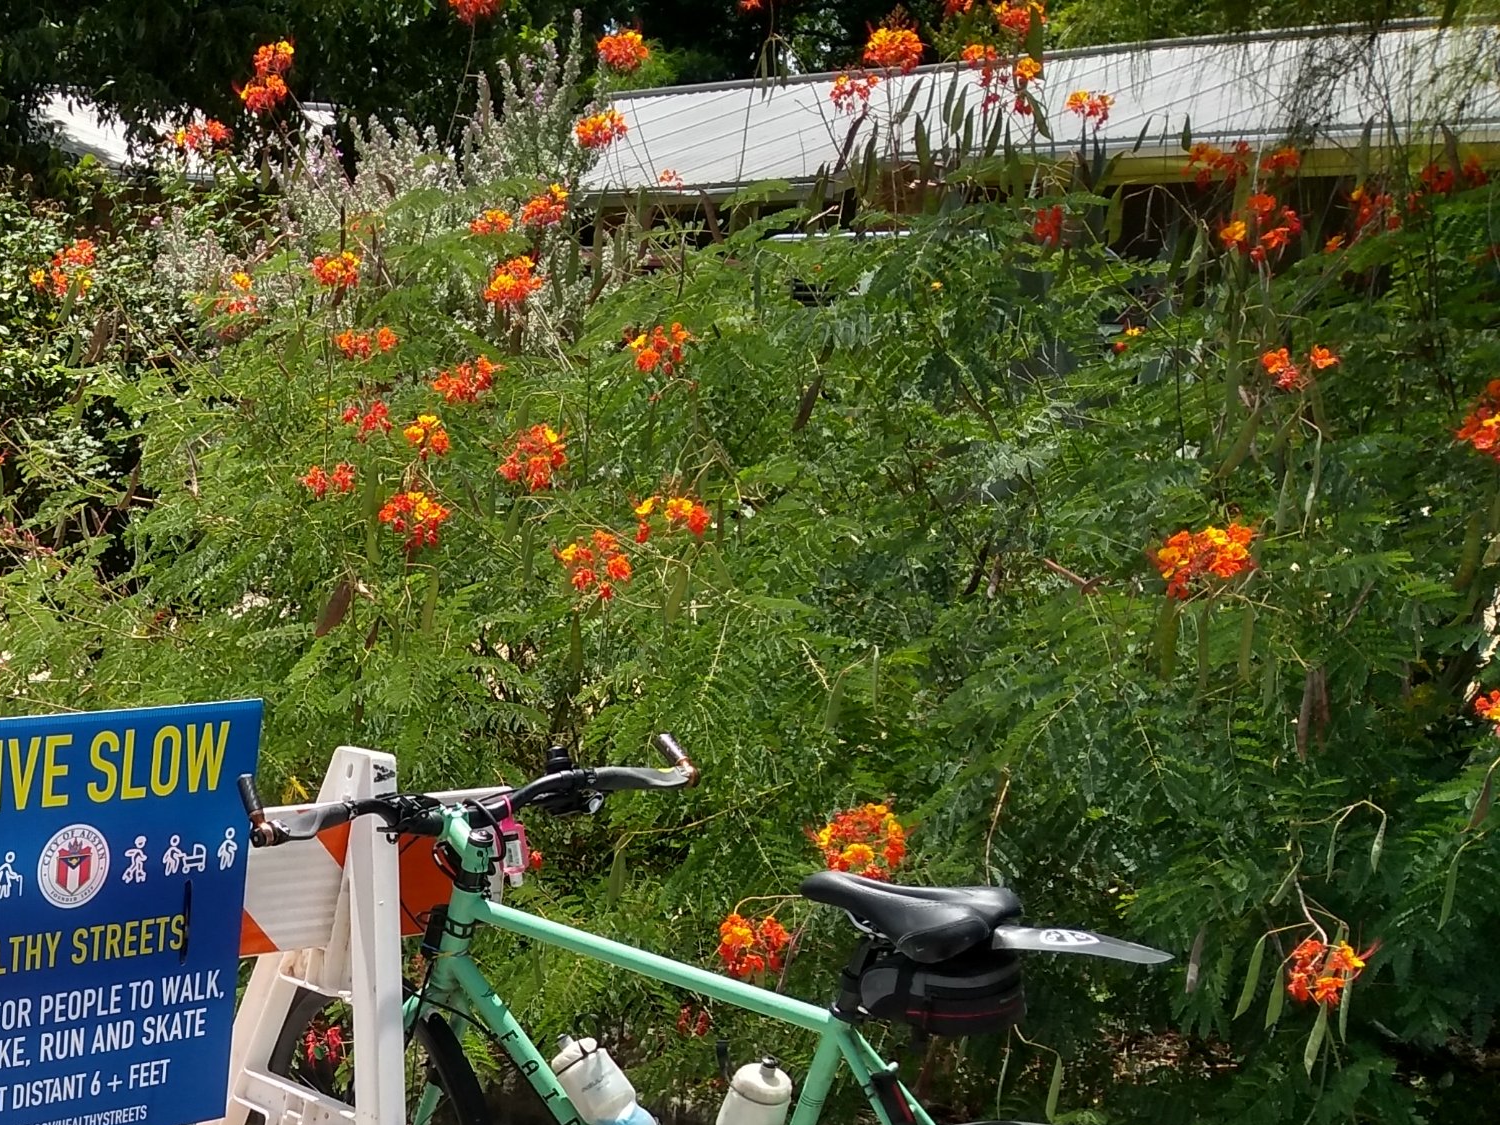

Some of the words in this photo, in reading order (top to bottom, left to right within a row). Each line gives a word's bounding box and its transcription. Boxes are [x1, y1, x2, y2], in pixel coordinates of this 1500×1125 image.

[87, 721, 230, 802] SLOW
[43, 840, 60, 866] CITY
[62, 830, 76, 841] OF
[80, 830, 107, 860] AUSTIN
[71, 915, 184, 963] STREETS
[40, 986, 122, 1024] PEOPLE
[129, 980, 154, 1011] TO
[162, 970, 225, 1005] WALK,
[40, 1028, 85, 1063] RUN
[91, 1021, 135, 1054] AND
[142, 1008, 207, 1045] SKATE
[13, 1074, 87, 1109] DISTANT
[91, 1071, 101, 1095] 6
[106, 1074, 123, 1092] +
[129, 1059, 171, 1090] FEET
